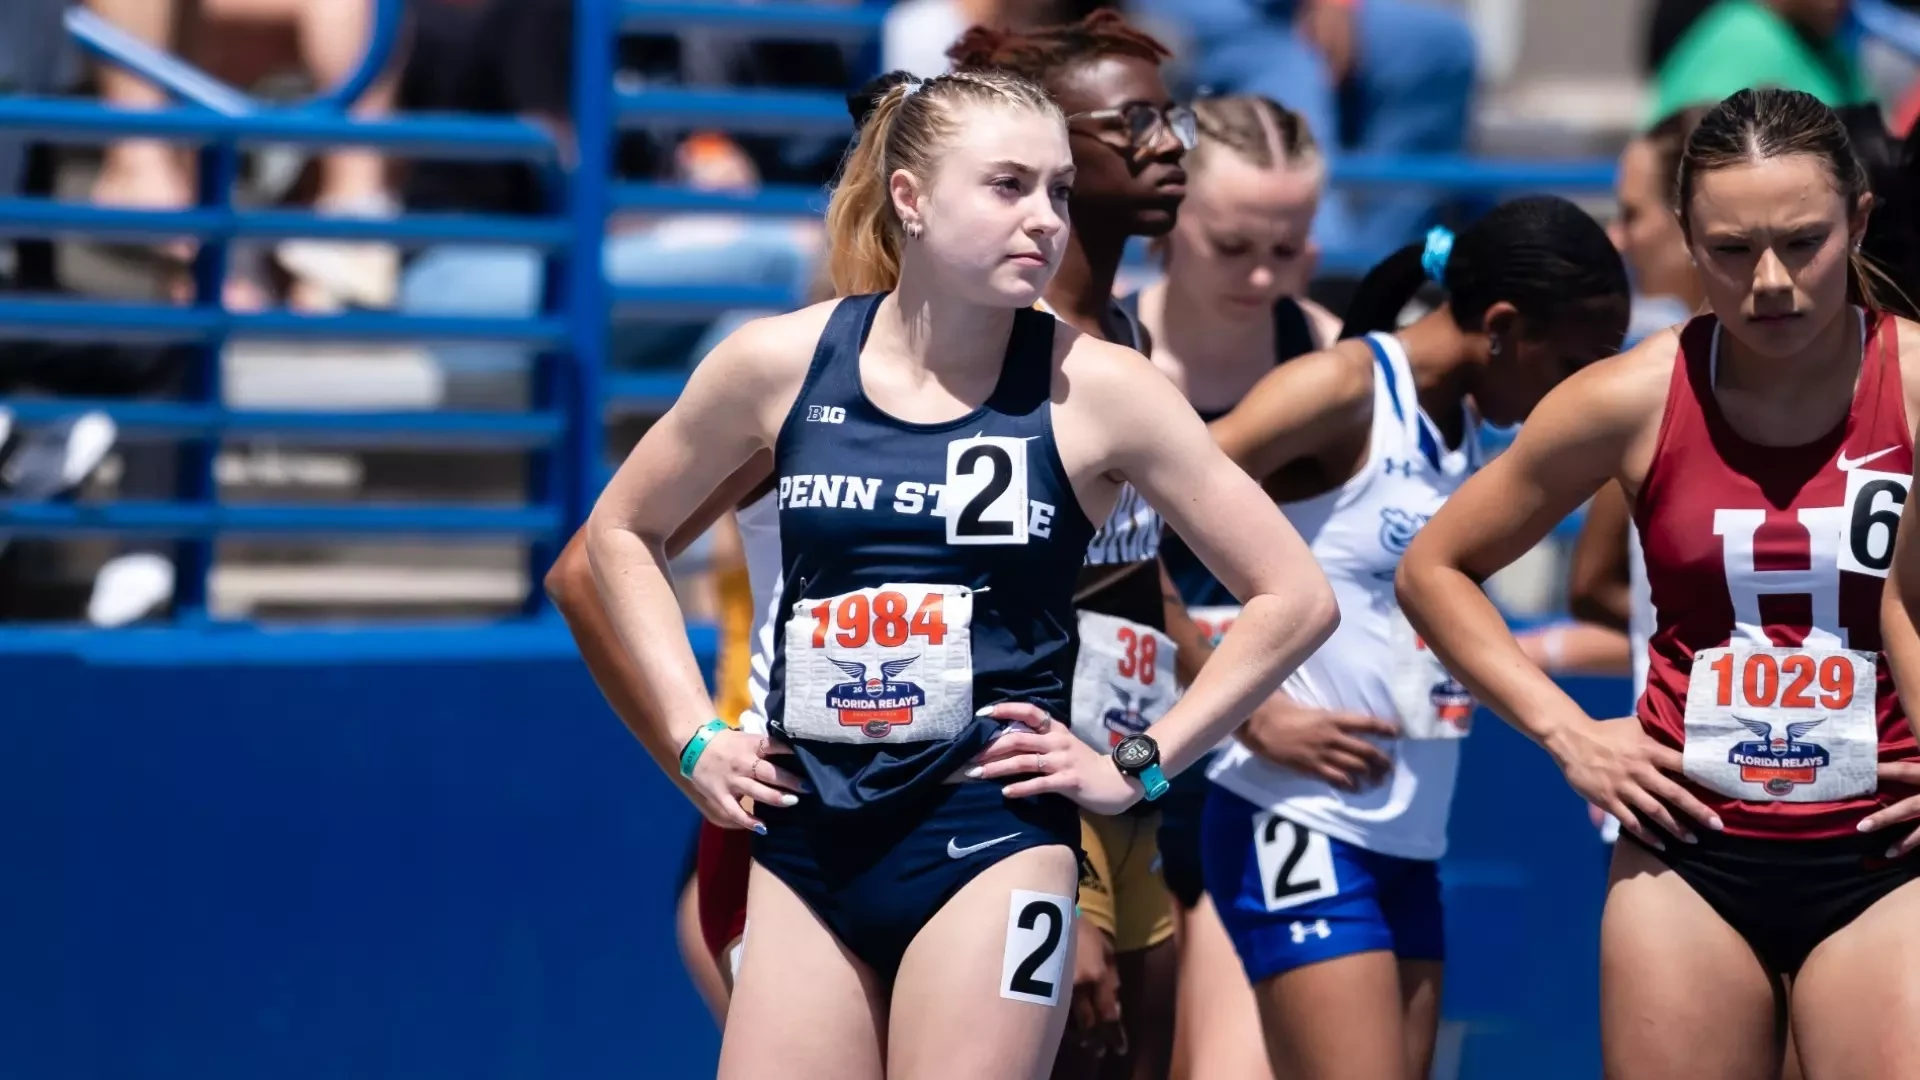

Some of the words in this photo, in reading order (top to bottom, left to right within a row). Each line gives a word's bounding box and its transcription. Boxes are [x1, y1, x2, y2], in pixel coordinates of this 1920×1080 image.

[806, 405, 846, 424] BIG
[779, 474, 882, 511] PENN
[893, 481, 1055, 540] STE
[956, 444, 1013, 536] 2
[1850, 479, 1908, 570] 6
[1713, 506, 1849, 650] H
[811, 591, 947, 648] 1984
[1117, 626, 1157, 686] 38
[1711, 653, 1855, 710] 1029
[831, 697, 877, 709] FLORIDA
[879, 695, 919, 708] RELAYS
[853, 686, 863, 694] 20
[1734, 754, 1780, 767] FLORIDA
[1782, 756, 1823, 768] RELAYS
[1265, 815, 1321, 899] 2
[1009, 900, 1063, 998] 2
